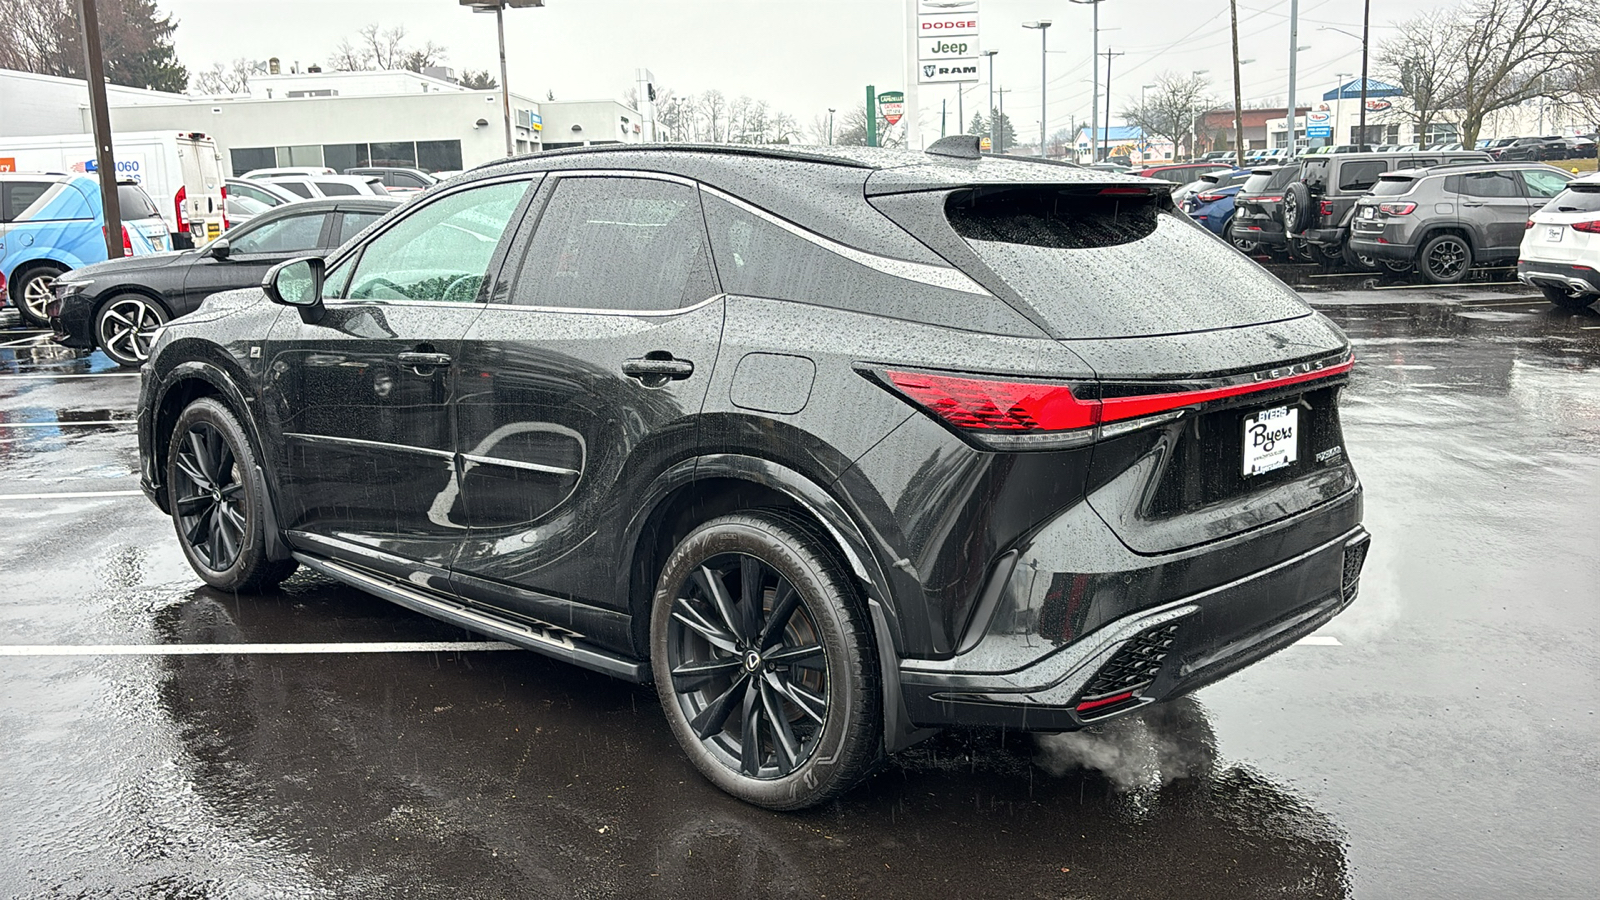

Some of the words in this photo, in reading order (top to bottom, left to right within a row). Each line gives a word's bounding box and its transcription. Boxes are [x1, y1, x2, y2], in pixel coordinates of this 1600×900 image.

[922, 21, 976, 29] DODGE
[931, 40, 968, 55] Jeep
[939, 66, 977, 74] RAM
[1253, 361, 1324, 380] LEXUS
[1258, 405, 1288, 422] BYERS
[1248, 423, 1293, 452] Byers
